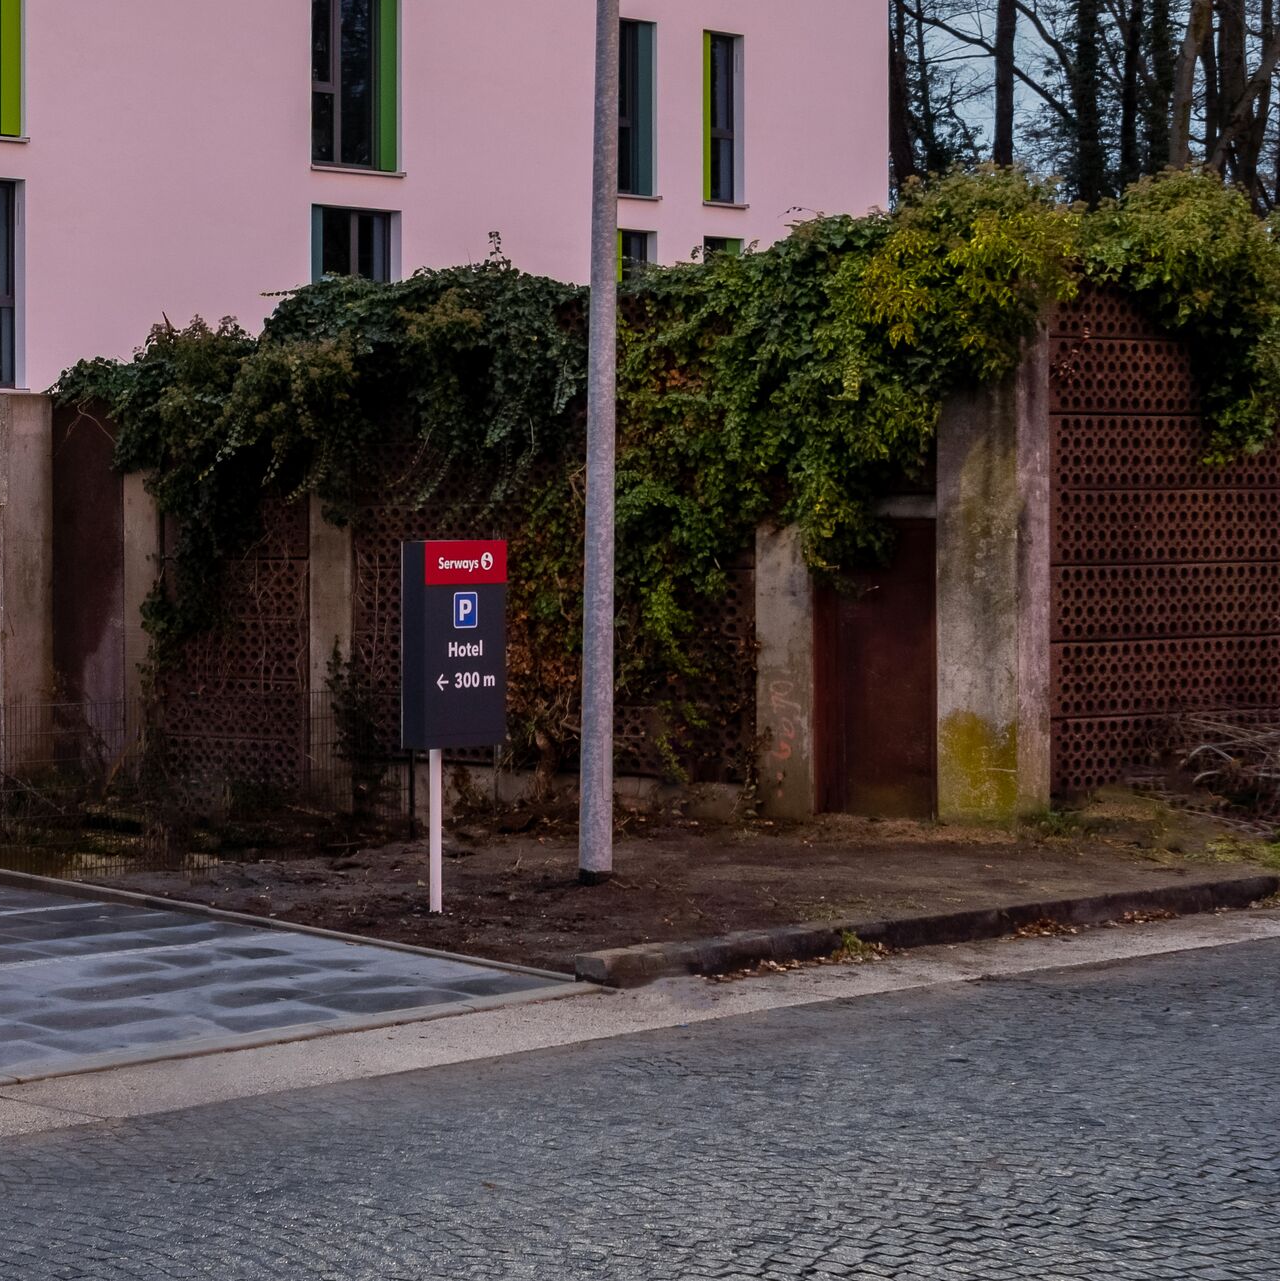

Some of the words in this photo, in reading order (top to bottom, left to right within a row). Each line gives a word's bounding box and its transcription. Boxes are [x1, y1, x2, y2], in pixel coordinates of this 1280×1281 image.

[438, 556, 480, 573] Serways
[459, 599, 473, 622] P
[448, 639, 483, 658] Hotel
[454, 671, 481, 689] 300
[483, 674, 496, 687] m
